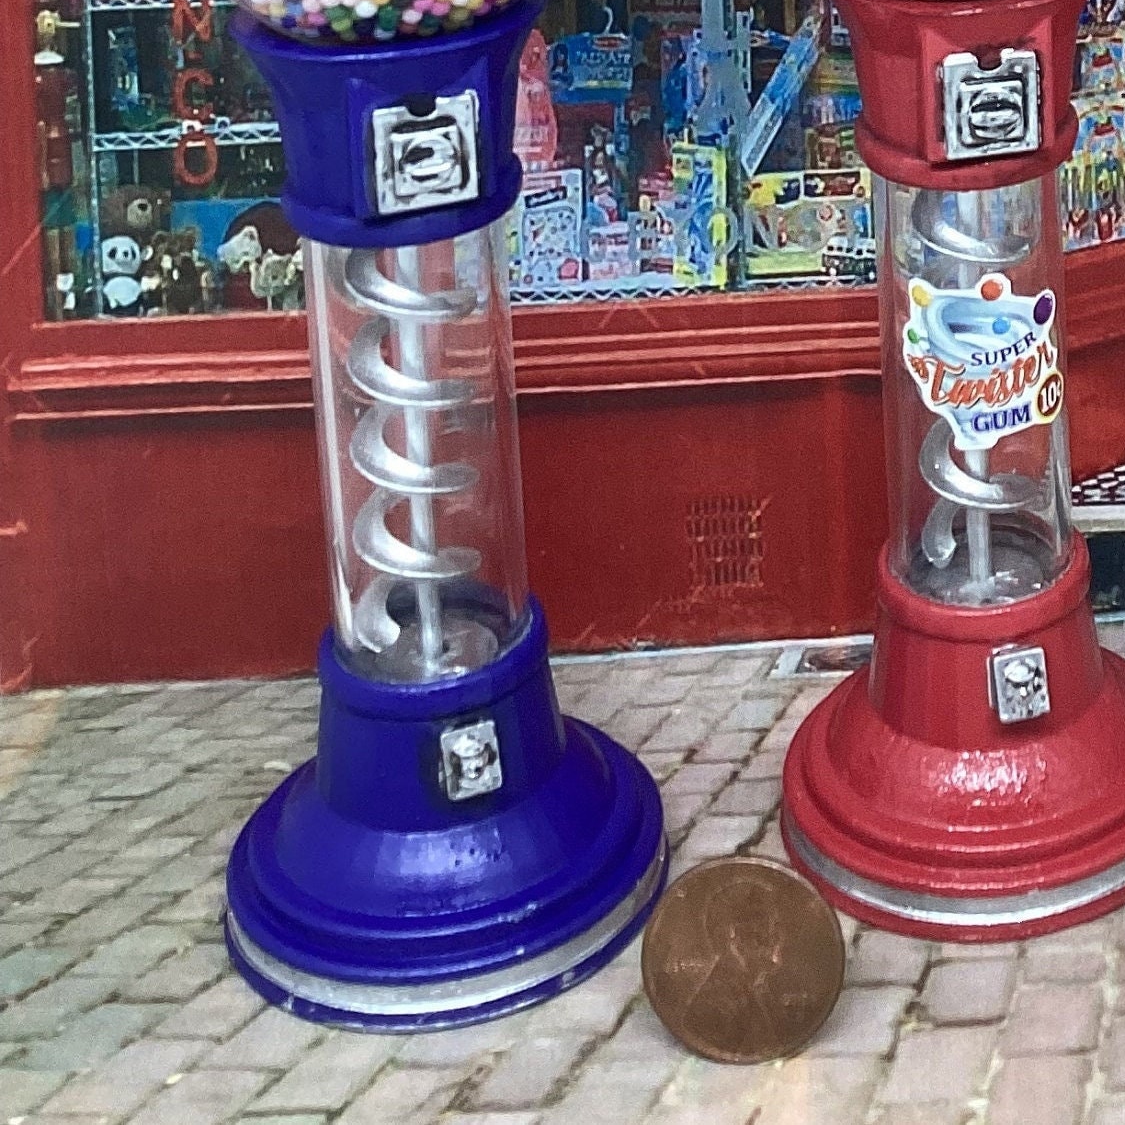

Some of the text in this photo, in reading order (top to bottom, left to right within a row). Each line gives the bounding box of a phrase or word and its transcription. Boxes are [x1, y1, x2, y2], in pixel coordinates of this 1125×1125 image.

[970, 331, 1038, 367] SUPER
[907, 341, 1054, 409] Twister
[973, 401, 1032, 433] GUM
